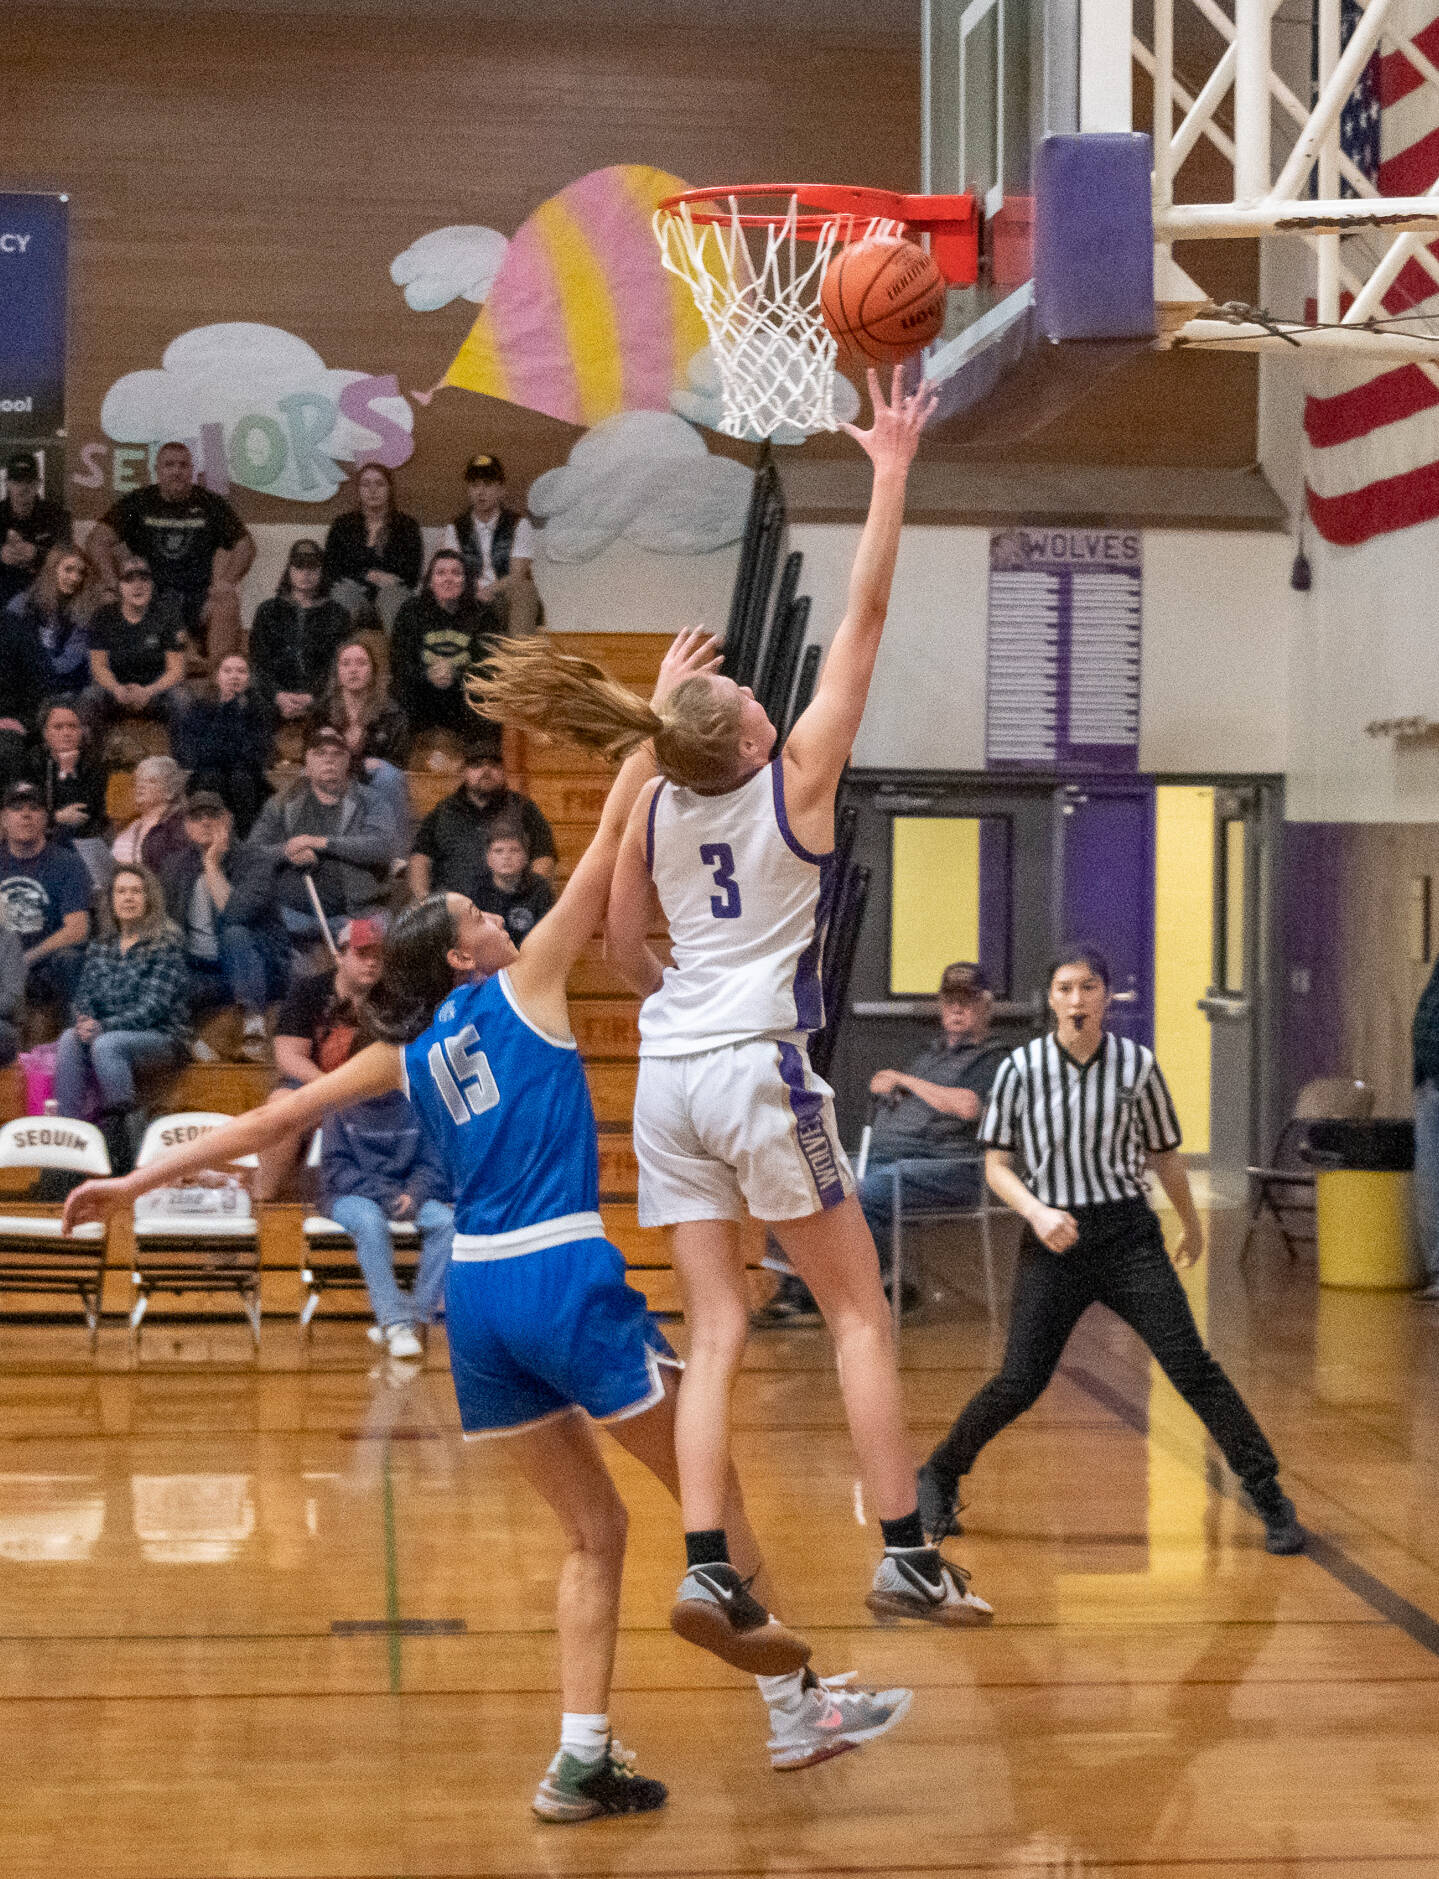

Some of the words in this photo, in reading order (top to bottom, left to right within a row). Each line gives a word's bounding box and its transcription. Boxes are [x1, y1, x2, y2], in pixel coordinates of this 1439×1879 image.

[0, 233, 31, 252] CY
[73, 374, 415, 495] SEIORS
[1023, 533, 1140, 560] WOLVES
[699, 842, 742, 919] 3
[427, 1023, 501, 1126] 15
